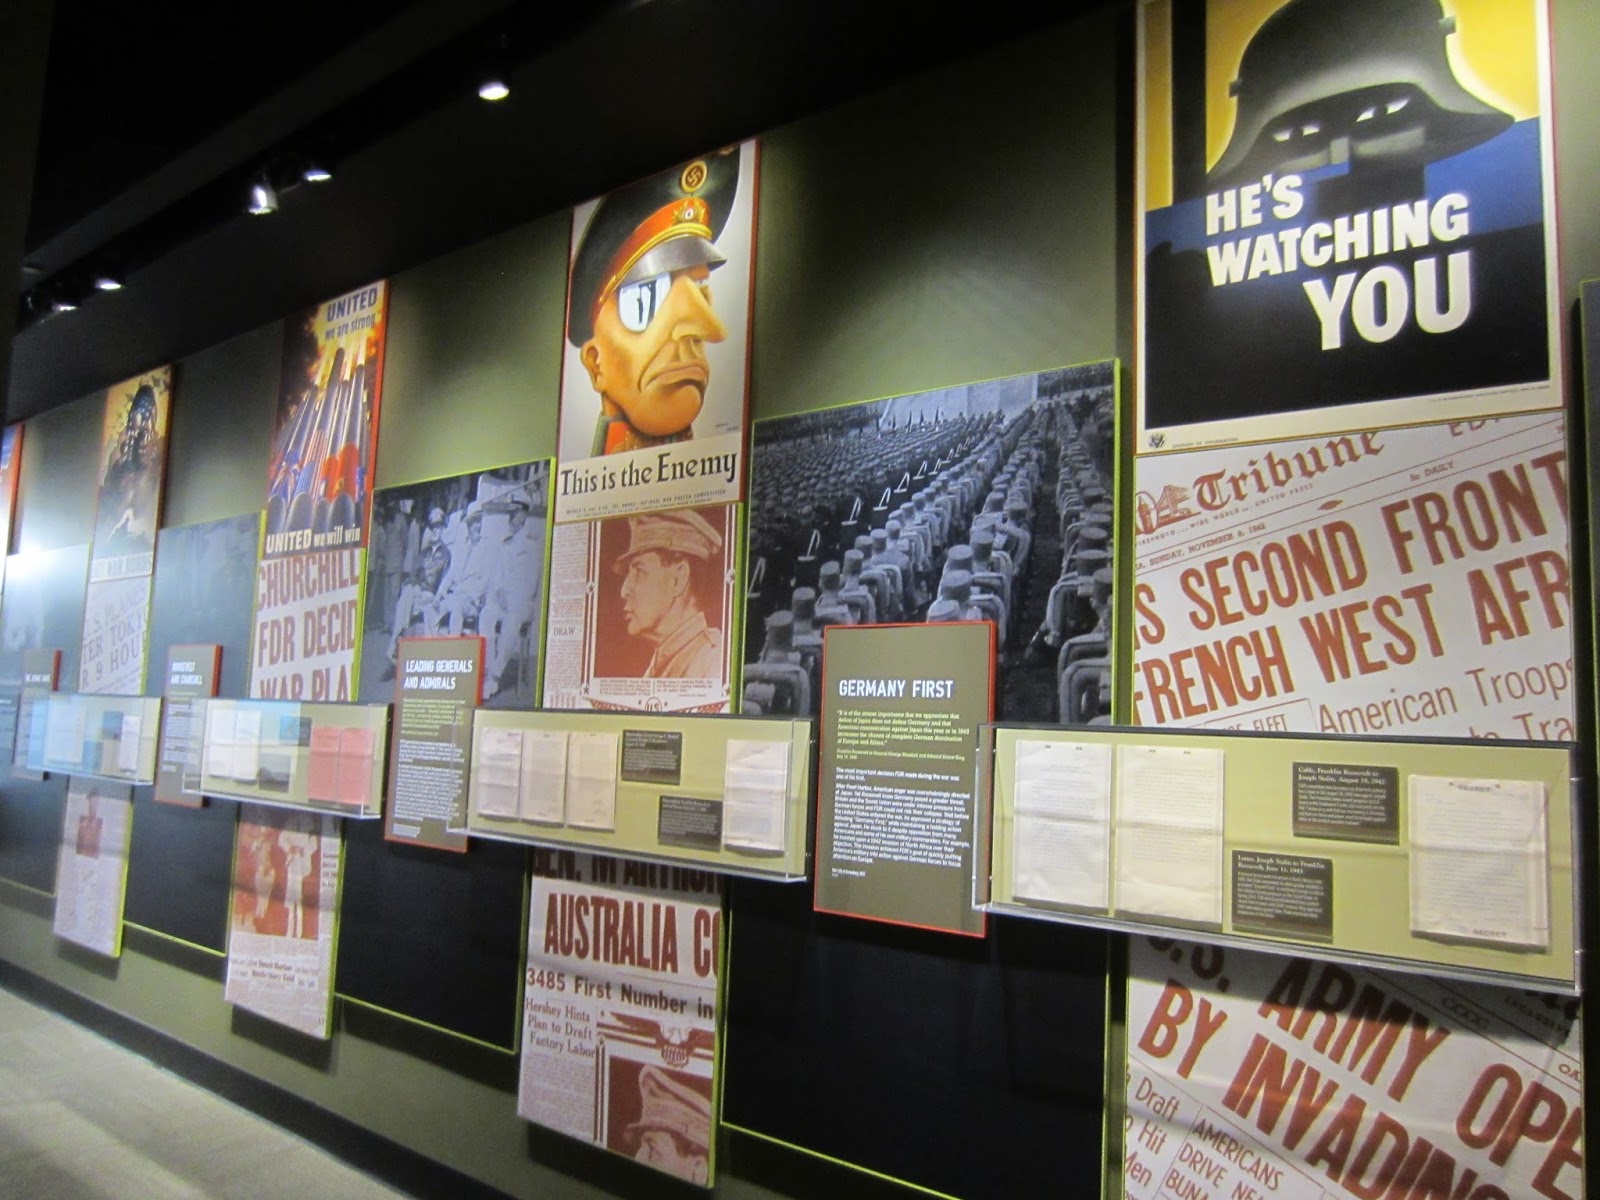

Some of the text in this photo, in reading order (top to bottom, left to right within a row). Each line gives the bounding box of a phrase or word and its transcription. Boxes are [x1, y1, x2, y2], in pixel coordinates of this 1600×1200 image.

[1206, 174, 1303, 236] HE'S
[1206, 192, 1469, 287] WATCHING
[327, 288, 377, 322] UNITED
[1302, 251, 1470, 351] YOU
[325, 313, 376, 341] we are strong
[560, 452, 738, 496] This is the Enemy
[1193, 432, 1384, 512] Tribune
[1424, 460, 1454, 477] DAILY
[1214, 507, 1239, 520] WORLD
[266, 523, 361, 554] UNITED we will win
[1150, 549, 1185, 567] SUNDAY,
[1189, 533, 1234, 554] NOVEMBER
[1180, 521, 1368, 631] SECOND
[1381, 451, 1567, 575] FRONT
[1300, 583, 1444, 683] WEST
[1467, 550, 1569, 646] AFR
[259, 615, 295, 668] FDR
[403, 676, 456, 690] AND ADMIRALS
[405, 660, 473, 673] LEADING GENERALS
[839, 680, 954, 698] GERMANY FIRST
[1319, 688, 1458, 734] American
[545, 893, 678, 973] AUSTRALIA
[526, 967, 713, 1020] 3485 First Number in
[526, 998, 590, 1022] Hershey Hints
[528, 1014, 592, 1040] Plan to Draft
[530, 1030, 596, 1058] Factory Labor
[1258, 957, 1450, 1103] ARMY
[1135, 1077, 1179, 1122] Draft
[1138, 979, 1511, 1200] BY INVADIN
[1138, 1119, 1167, 1155] Hit
[1192, 1118, 1283, 1191] AMERICANS
[1179, 1143, 1227, 1189] DRIVE
